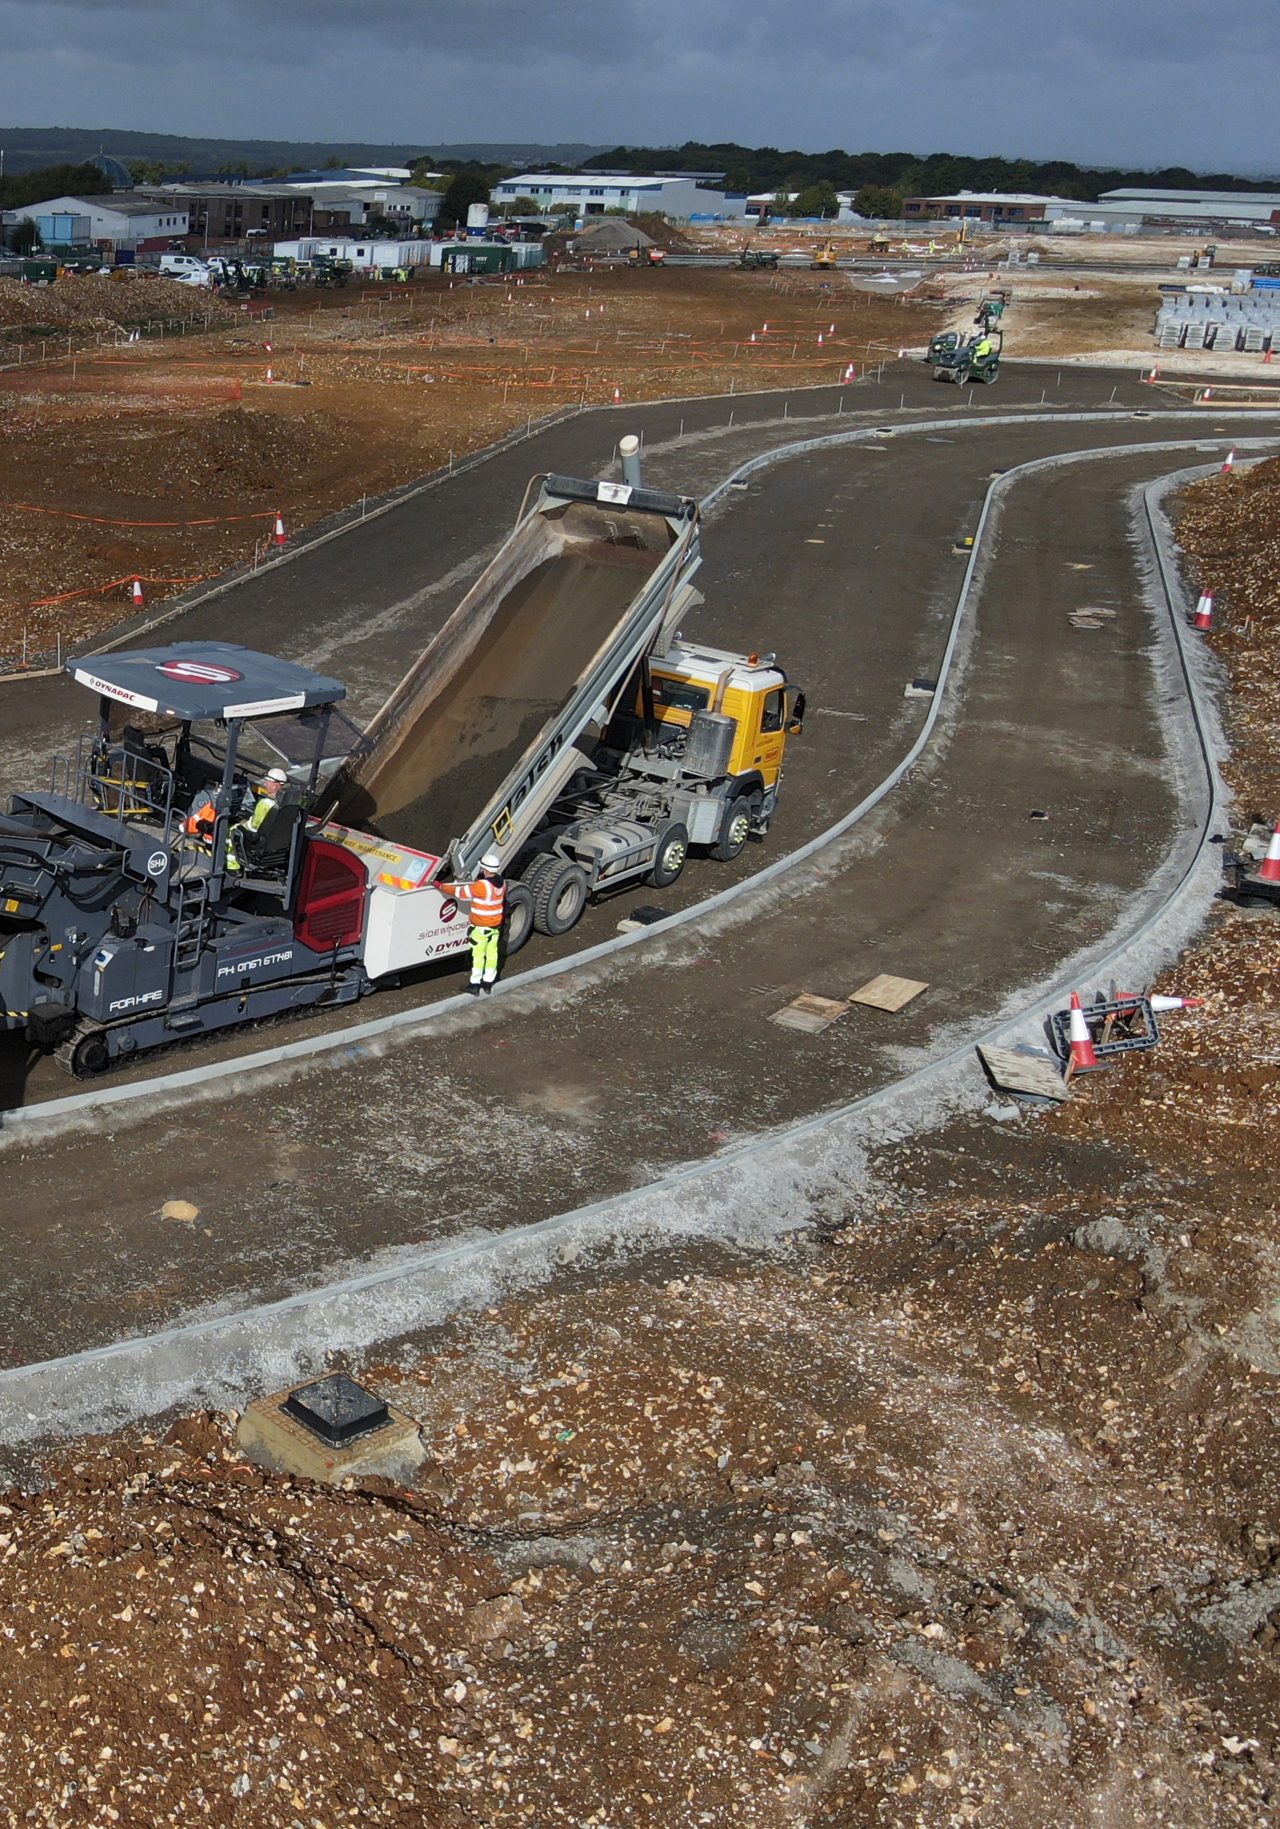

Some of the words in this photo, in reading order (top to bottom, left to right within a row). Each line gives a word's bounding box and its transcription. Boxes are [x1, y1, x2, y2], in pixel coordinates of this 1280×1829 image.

[95, 680, 136, 701] DYNAPAC
[150, 858, 165, 869] SH4
[435, 937, 472, 953] DYNA
[109, 997, 135, 1012] FOR
[134, 989, 163, 1005] HIRE
